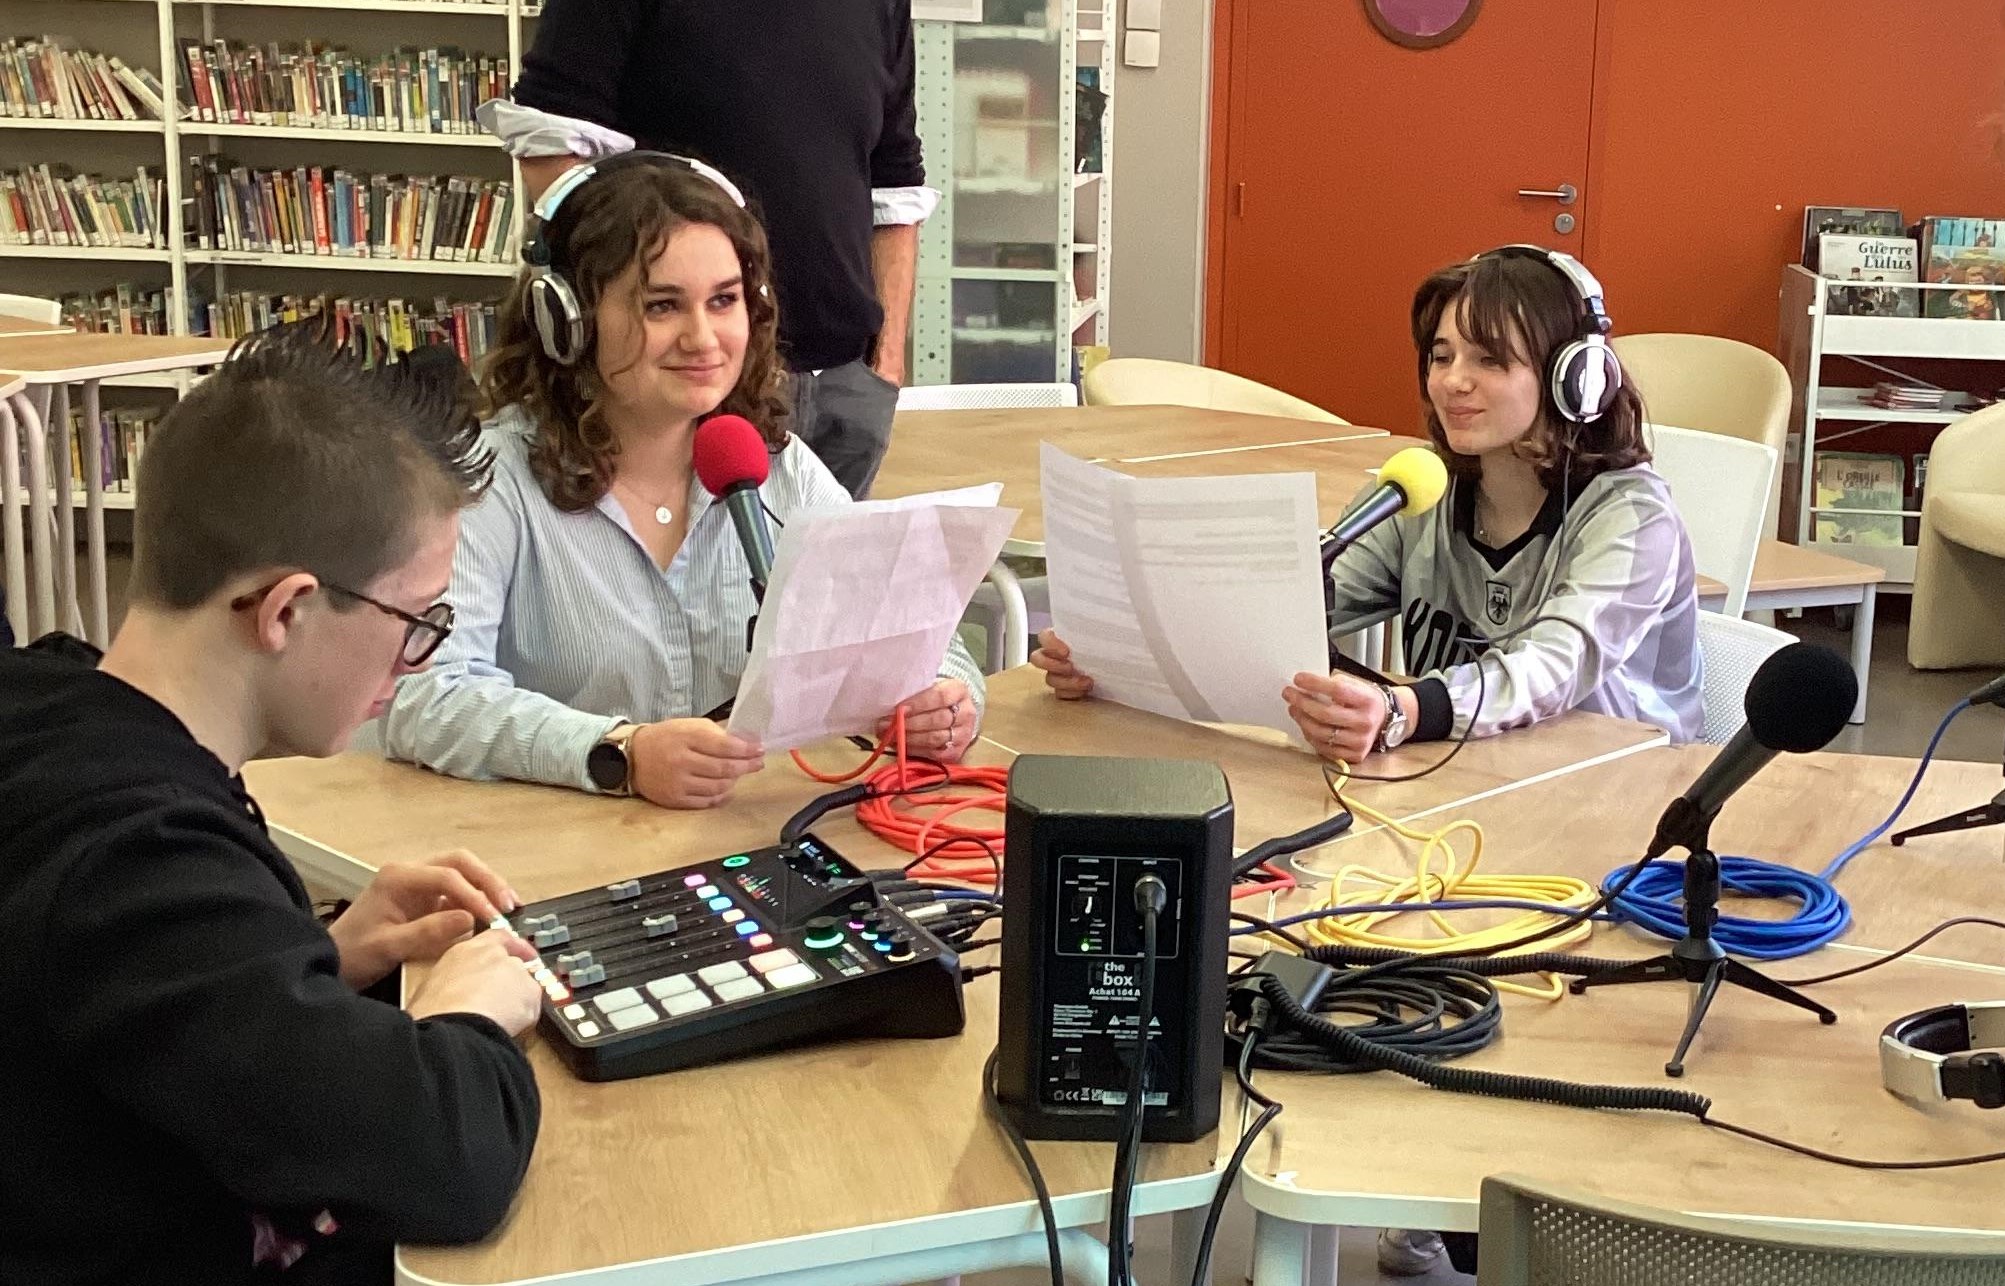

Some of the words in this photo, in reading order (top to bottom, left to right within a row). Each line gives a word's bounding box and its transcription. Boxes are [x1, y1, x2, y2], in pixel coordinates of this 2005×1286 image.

[1859, 241, 1913, 255] Guerre
[1864, 255, 1913, 270] Lulus
[1103, 961, 1126, 972] the
[1102, 972, 1134, 987] box
